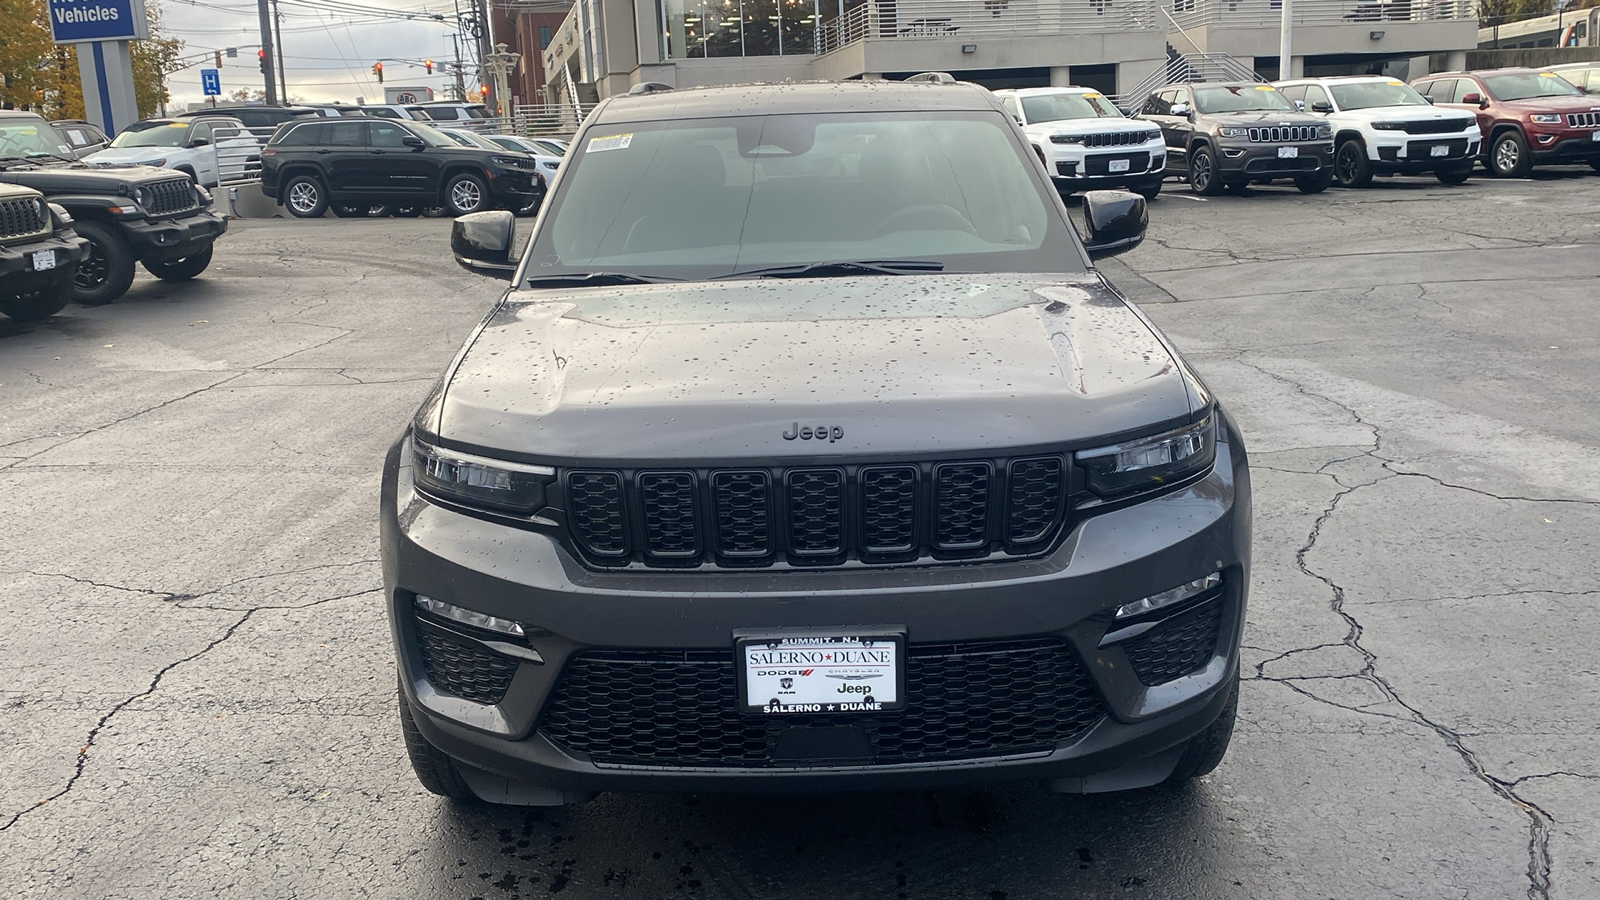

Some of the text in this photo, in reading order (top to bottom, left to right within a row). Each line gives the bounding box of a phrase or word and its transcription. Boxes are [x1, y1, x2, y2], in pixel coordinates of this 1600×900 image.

[54, 5, 118, 23] Vehicles
[205, 75, 217, 88] H
[400, 94, 415, 104] ABC
[782, 422, 844, 443] Jeep
[750, 651, 890, 665] SALERNO DUANE
[837, 682, 872, 696] Jeep
[763, 703, 882, 713] SALERNO DUANE
